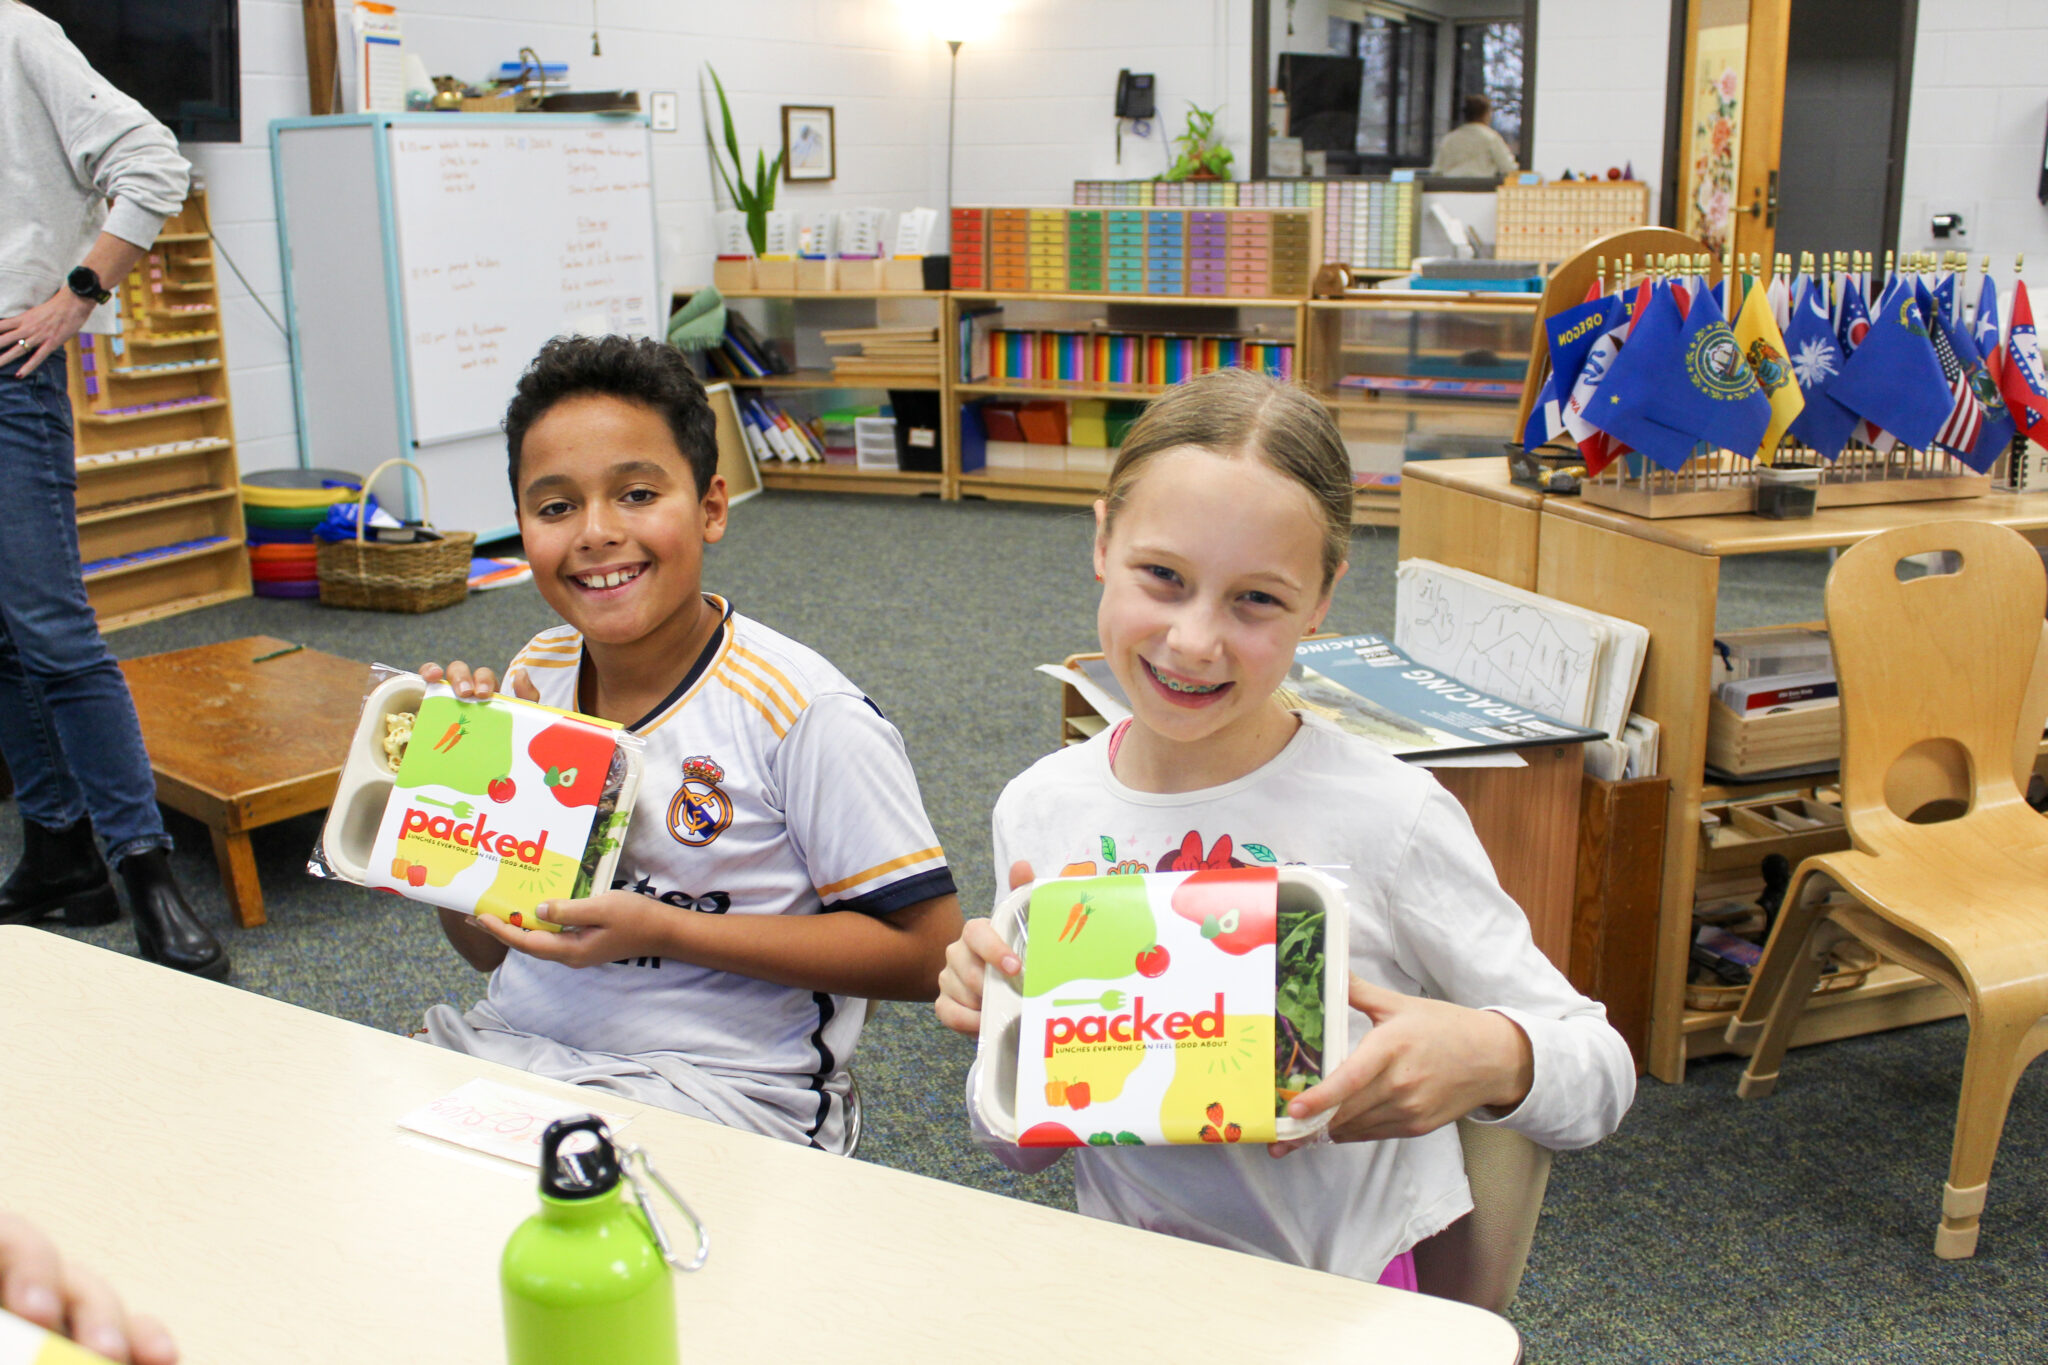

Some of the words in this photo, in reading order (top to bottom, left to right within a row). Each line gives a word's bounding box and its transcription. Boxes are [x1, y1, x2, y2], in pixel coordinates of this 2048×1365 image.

[1401, 669, 1536, 723] TRACING
[398, 808, 549, 866] packed
[407, 833, 436, 844] LUNCHES
[437, 841, 469, 853] EVERYONE
[470, 849, 484, 858] CAN
[485, 854, 499, 862] FEEL
[500, 858, 518, 867] GOOD
[519, 864, 541, 873] ABOUT
[1044, 992, 1225, 1059] packed
[1055, 1046, 1091, 1054] LUNCHES
[1093, 1045, 1133, 1053] EVERYONE
